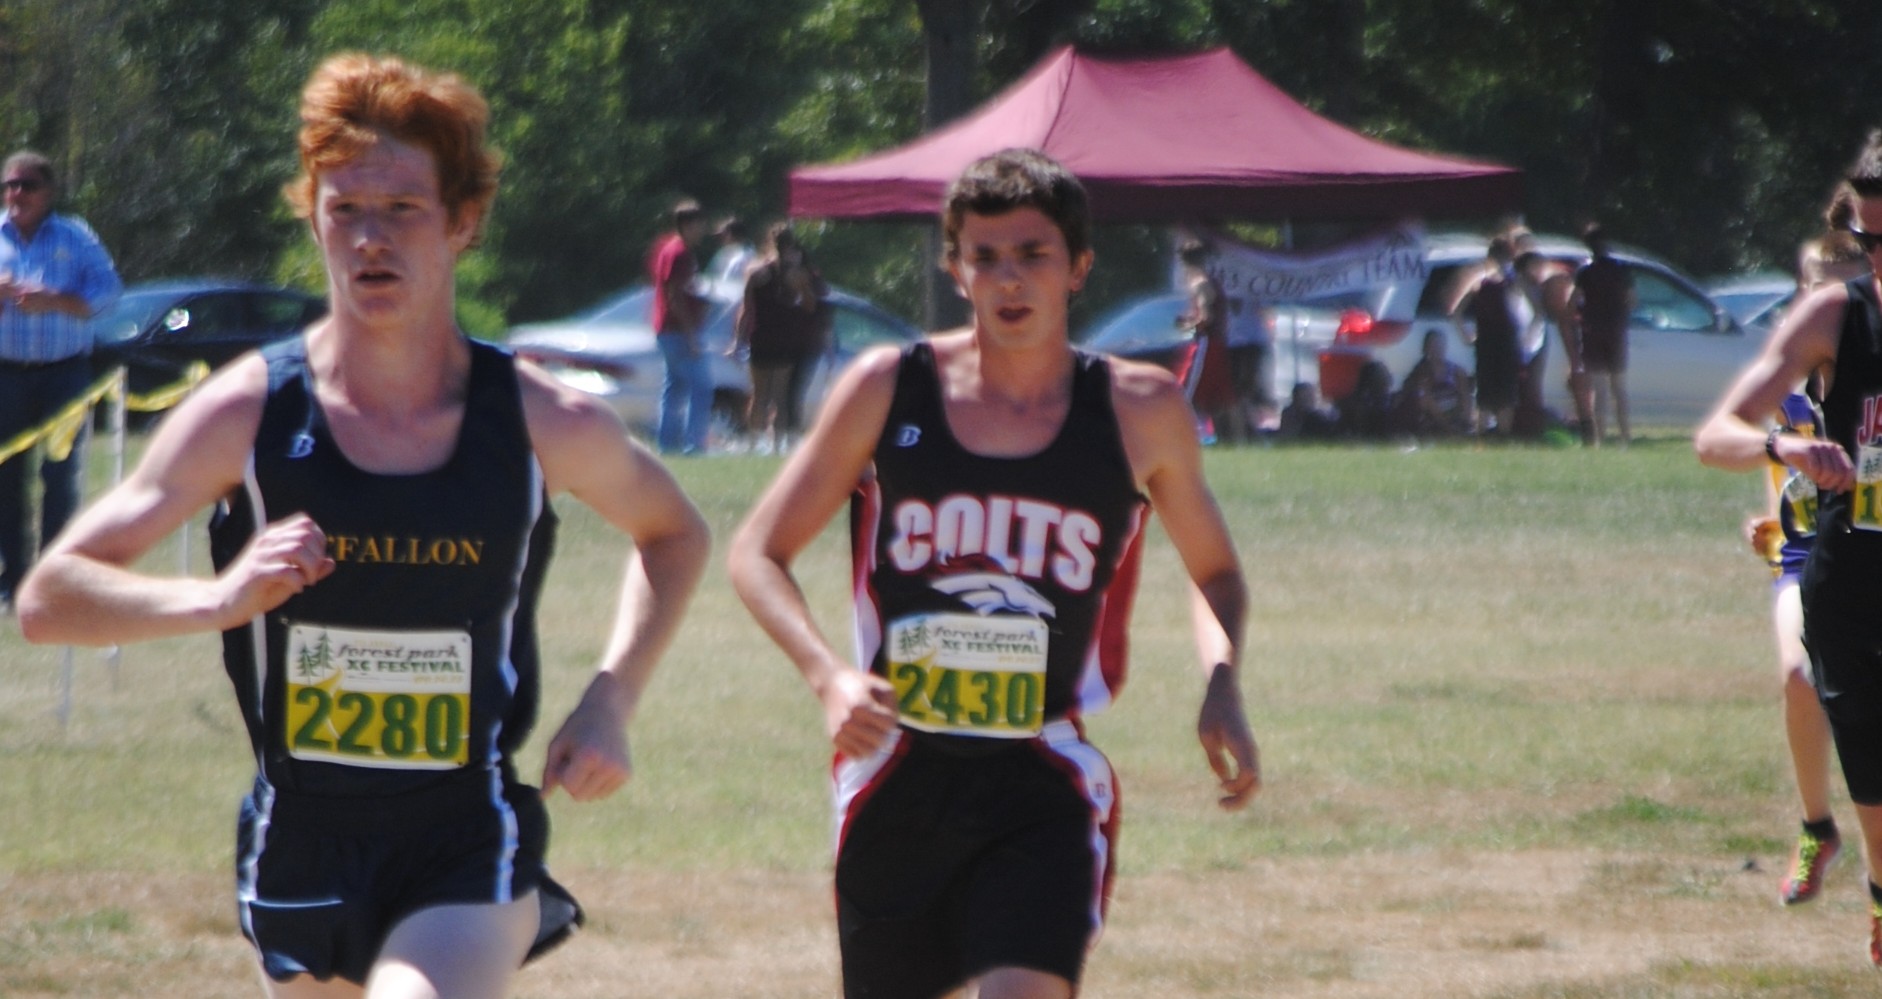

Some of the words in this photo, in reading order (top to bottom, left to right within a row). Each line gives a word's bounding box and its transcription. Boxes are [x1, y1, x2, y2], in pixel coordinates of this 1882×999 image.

[1362, 249, 1427, 282] TEAM
[889, 493, 1101, 594] COLTS
[935, 625, 991, 640] forest
[993, 630, 1037, 643] park
[338, 644, 404, 658] forest
[406, 645, 459, 661] park
[967, 641, 1043, 655] FESTIVAL
[347, 659, 371, 671] XC
[377, 660, 464, 673] FESTIVAL
[897, 663, 1038, 728] 2430
[294, 686, 463, 760] 2280
